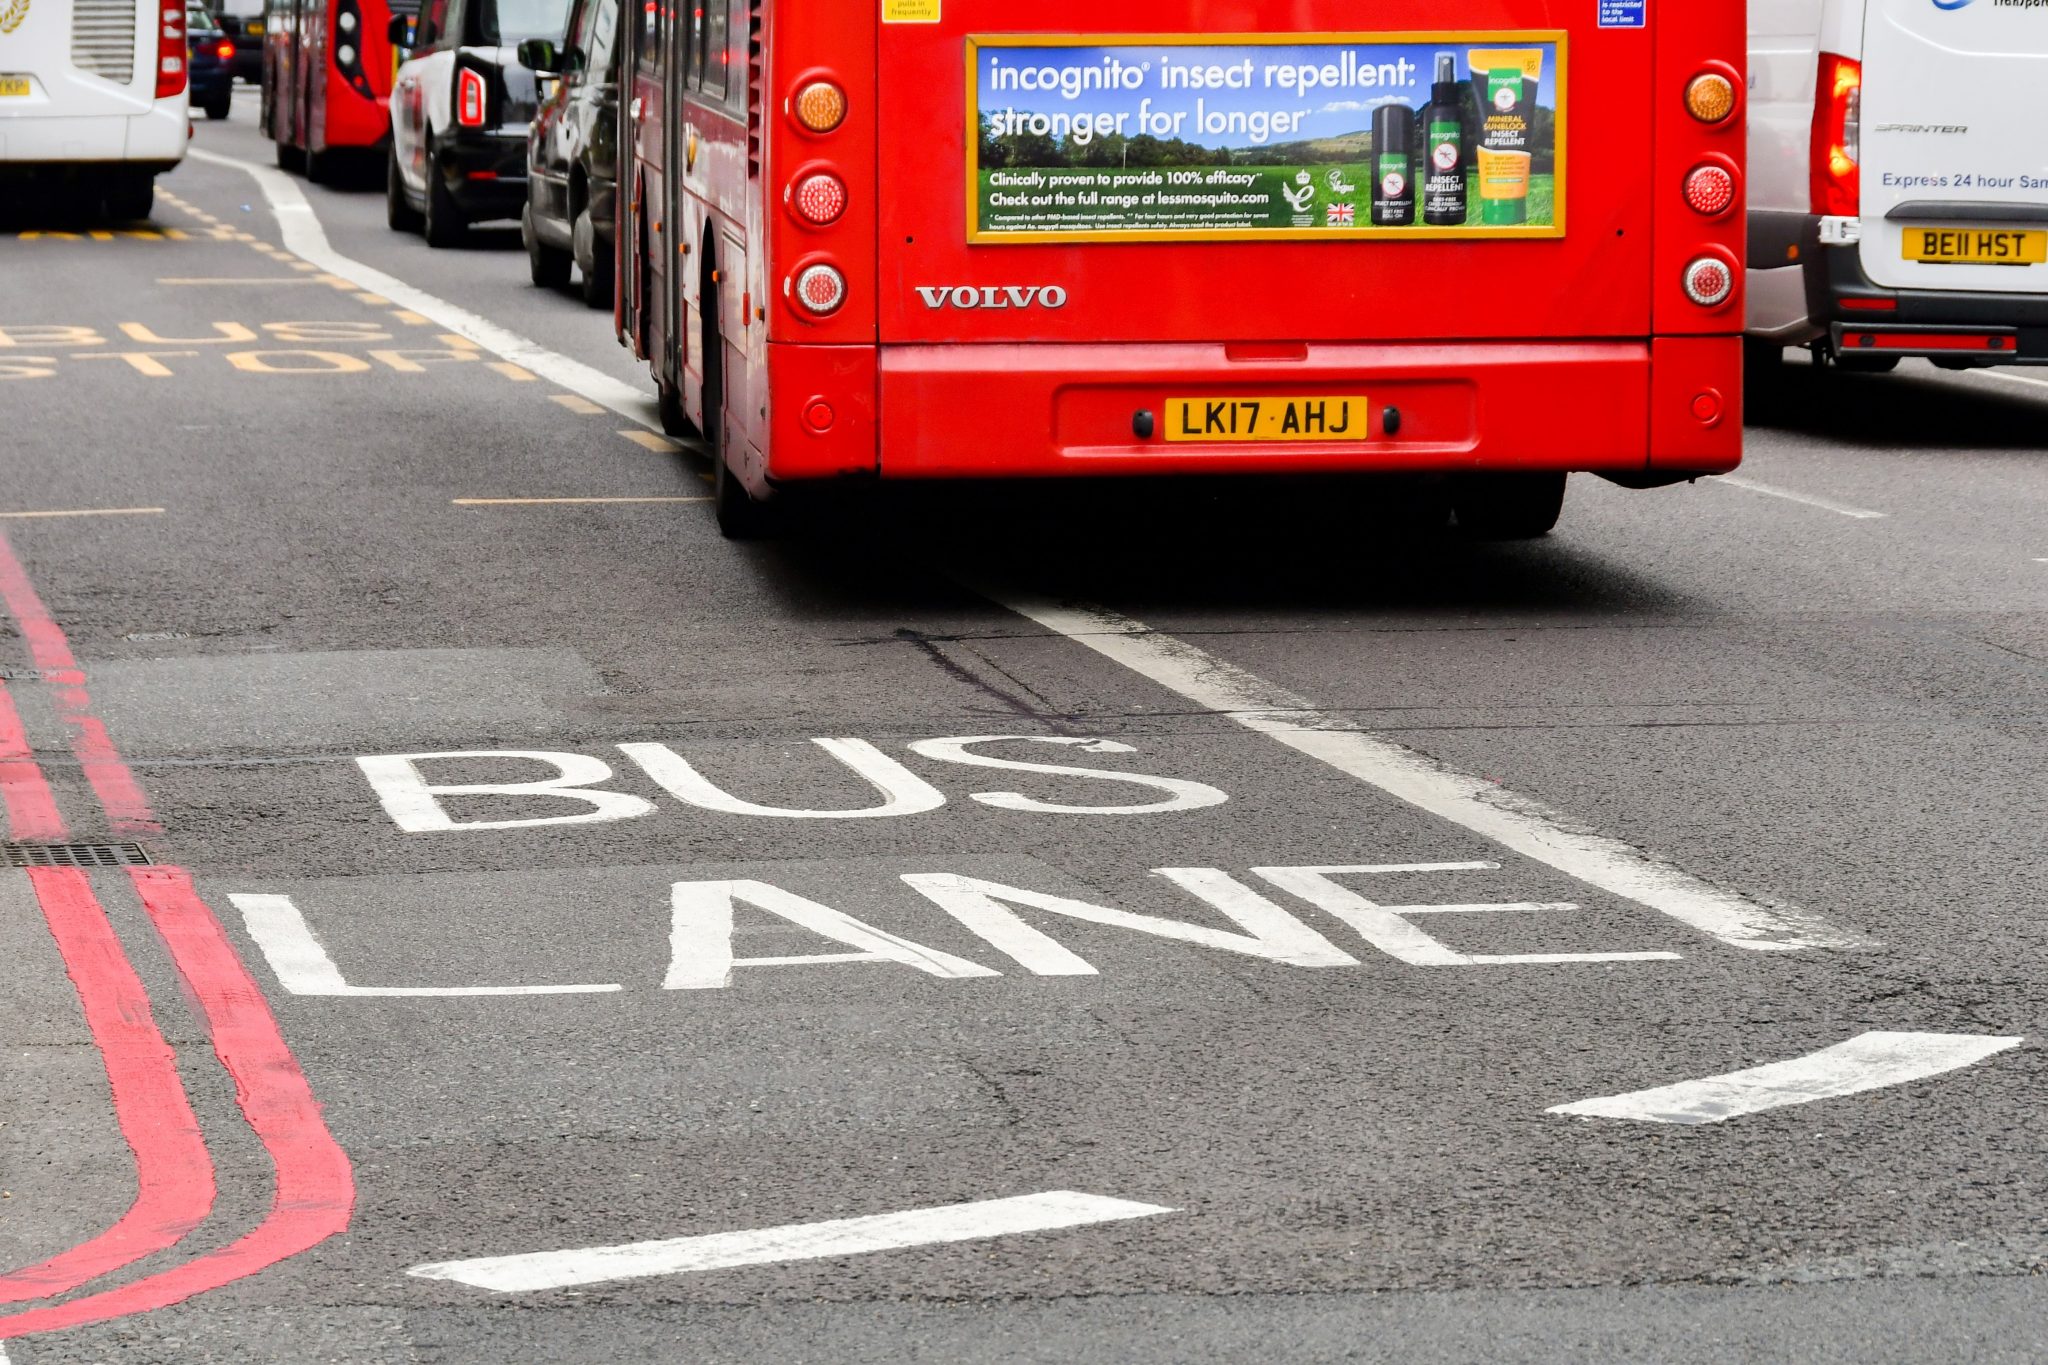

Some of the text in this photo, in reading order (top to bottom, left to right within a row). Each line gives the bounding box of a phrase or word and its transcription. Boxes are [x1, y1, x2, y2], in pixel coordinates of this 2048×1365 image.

[891, 8, 932, 16] frequently
[1161, 55, 1254, 88] insect
[1264, 50, 1416, 97] repellent:
[990, 106, 1130, 146] stronger
[1138, 98, 1187, 134] for
[1875, 123, 1968, 133] SPRINTER
[1484, 137, 1526, 145] REPELLENT
[990, 171, 1046, 188] Clinically
[1049, 175, 1094, 188] proven
[1097, 174, 1110, 185] to
[1114, 171, 1163, 188] provide
[1167, 171, 1203, 184] 100%
[1425, 183, 1464, 191] REPELLENT
[1430, 175, 1459, 183] INSECT
[1883, 172, 1948, 188] Express
[1954, 174, 1971, 187] 24
[1977, 175, 2014, 188] hour
[990, 191, 1269, 208] Check out the full range at lessmosquito.com
[1978, 233, 2025, 256] HST
[915, 286, 1067, 308] VOLVO
[1282, 401, 1348, 433] AHJ
[355, 734, 1229, 833] BUS
[228, 862, 1682, 996] LANE
